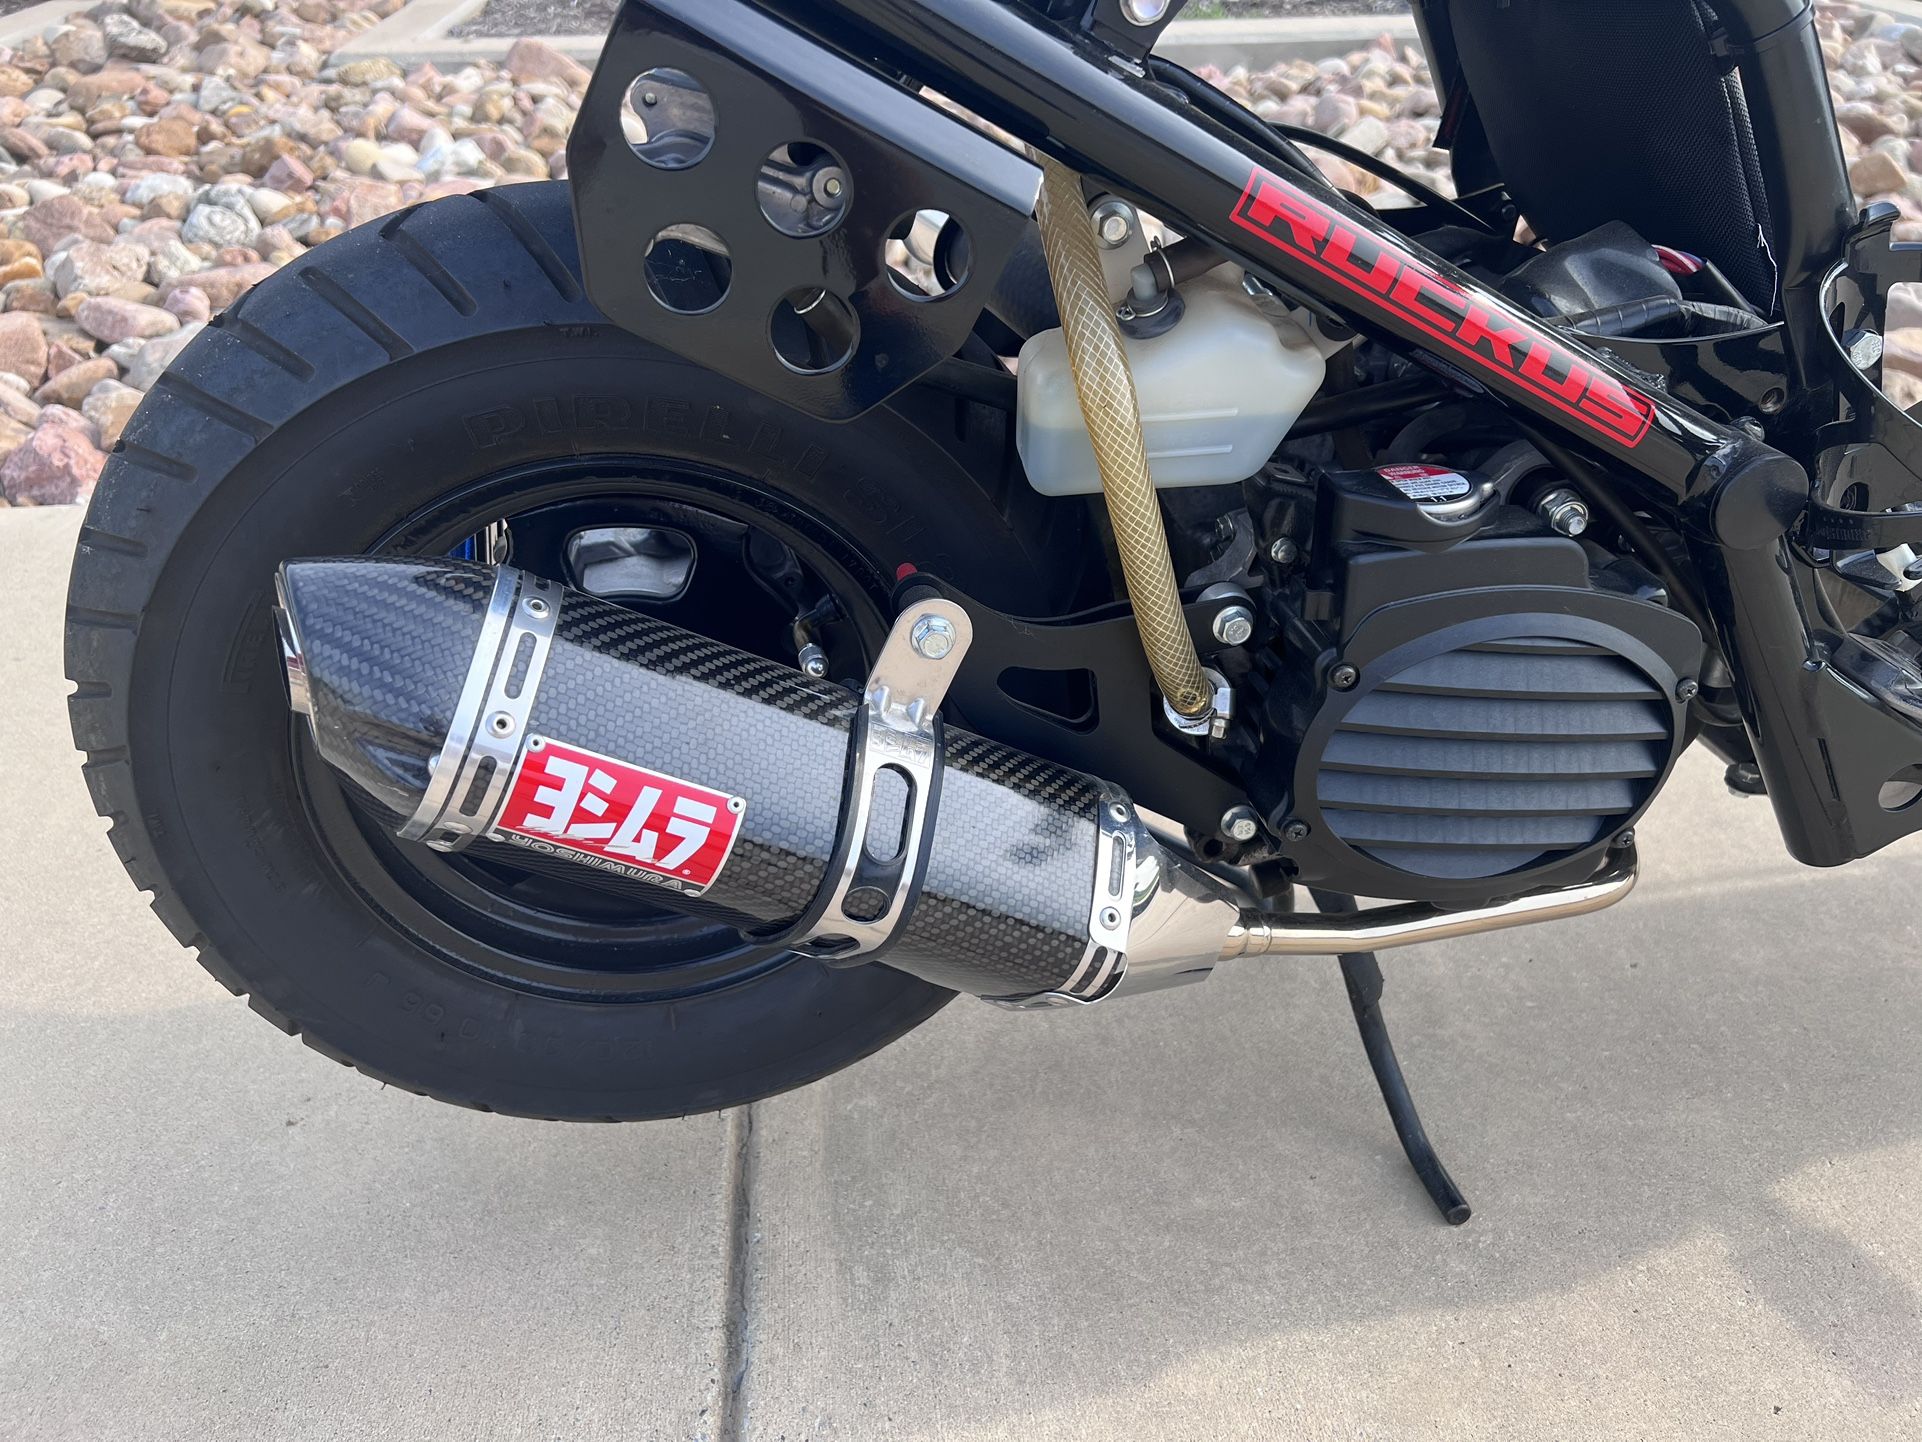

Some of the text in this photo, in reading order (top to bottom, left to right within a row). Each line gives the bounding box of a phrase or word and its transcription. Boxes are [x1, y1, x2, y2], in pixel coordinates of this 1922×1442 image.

[1247, 181, 1649, 437] RUCKUS
[462, 394, 828, 480] PIRELLI
[508, 833, 684, 890] YOSHIMURA
[521, 755, 718, 871] ヨシムラ
